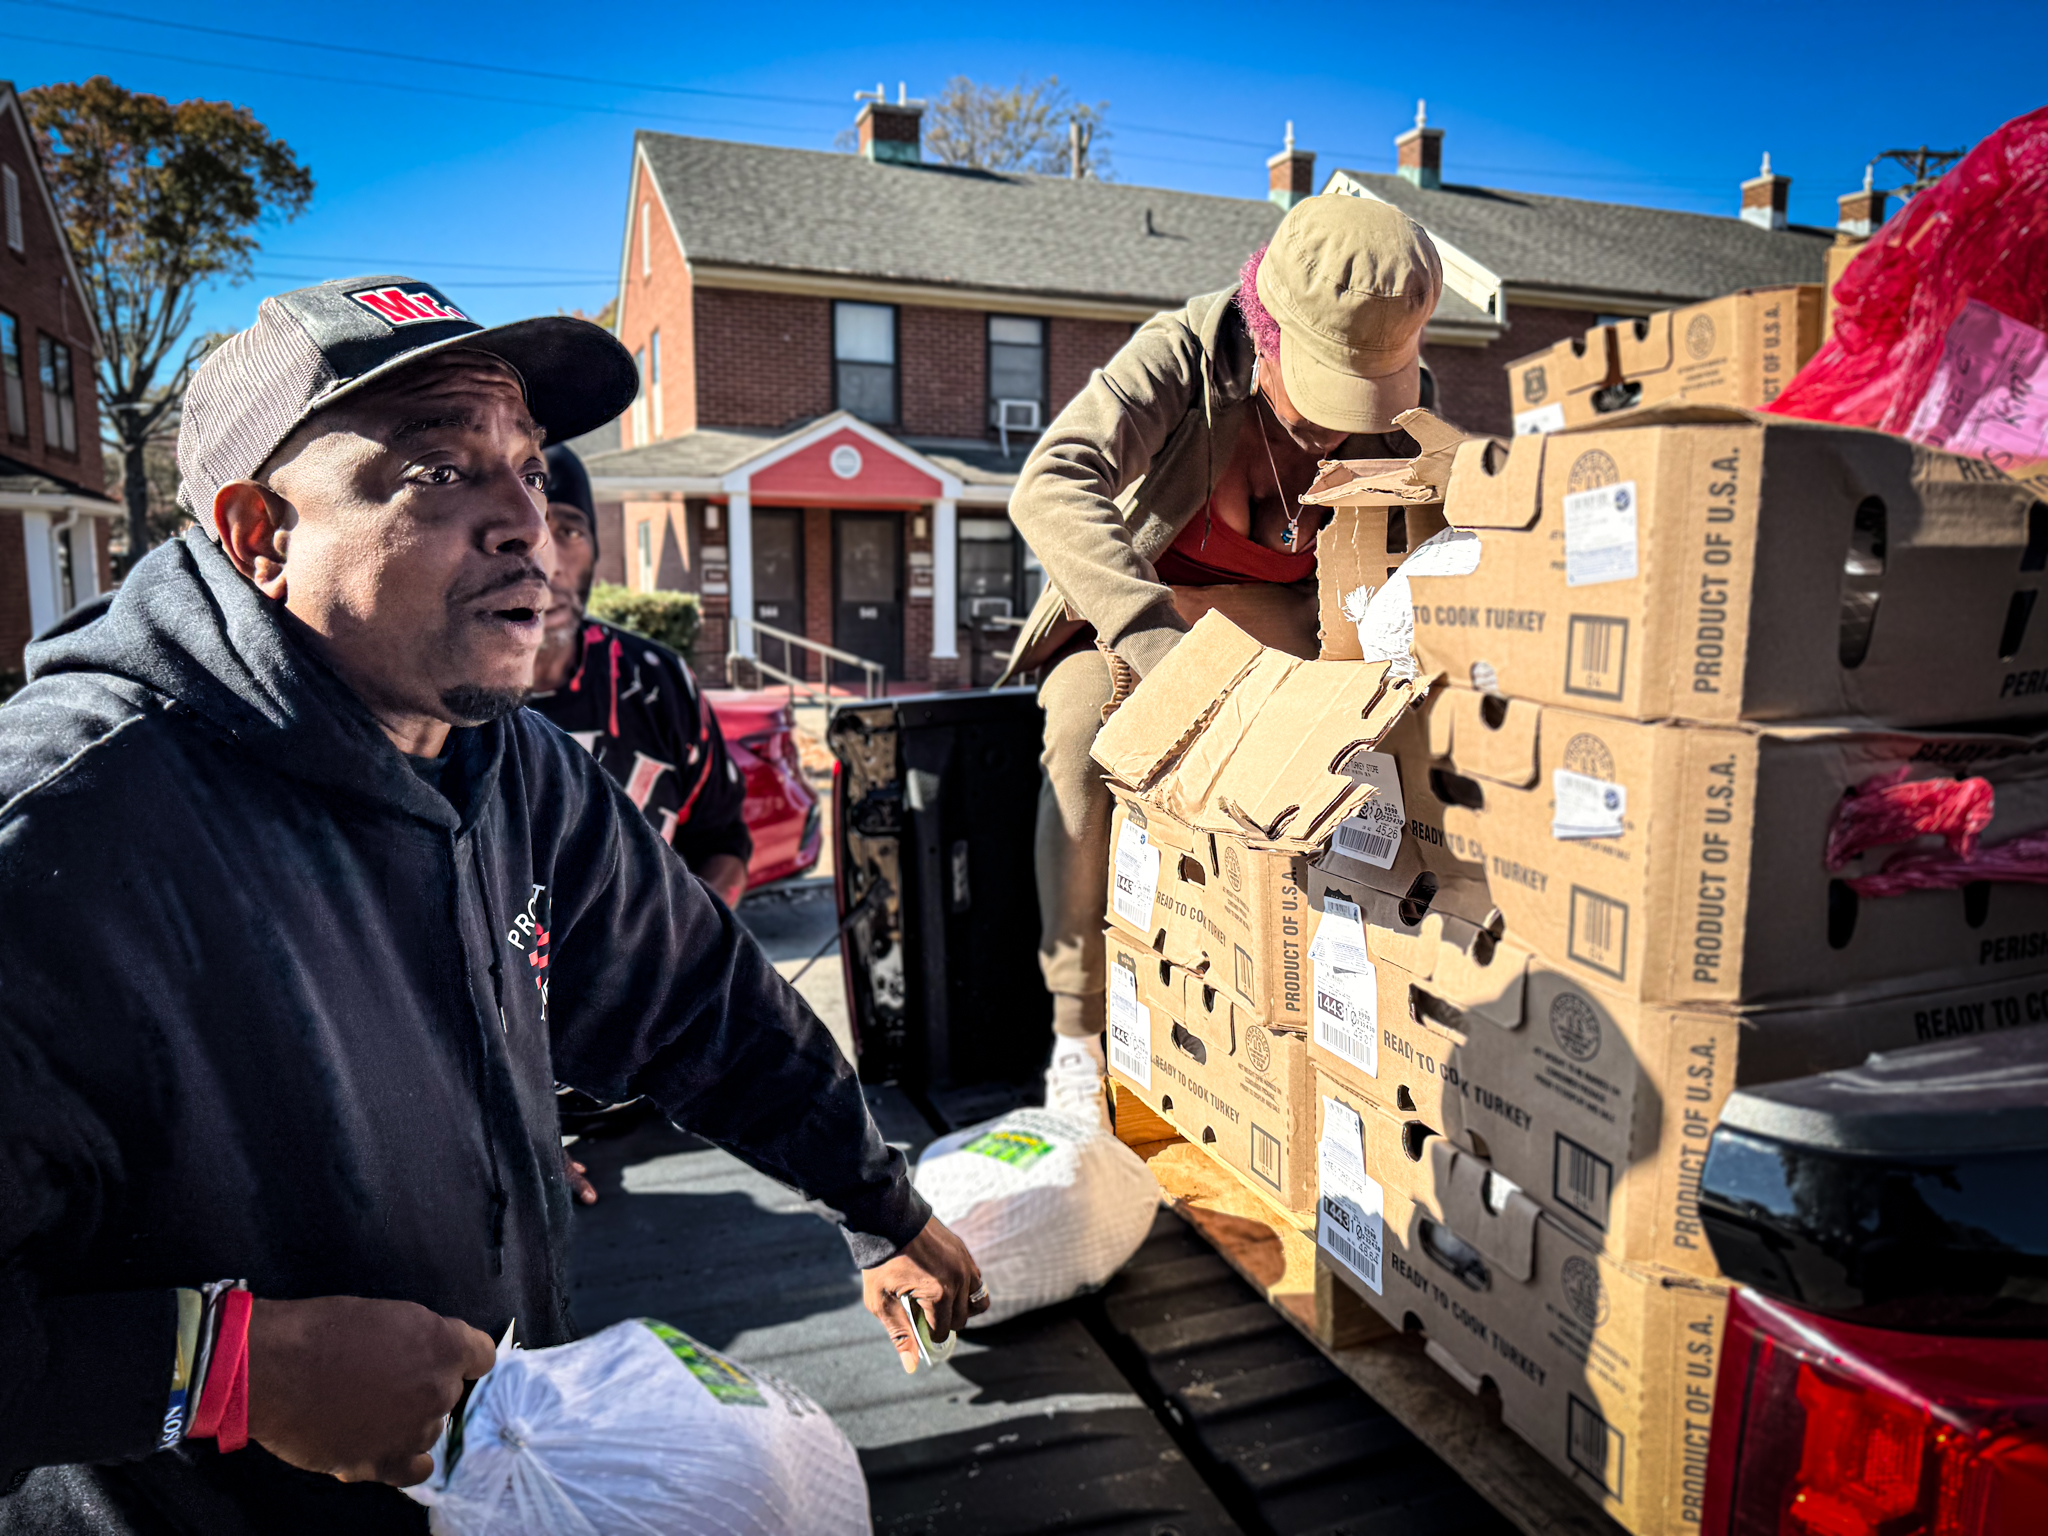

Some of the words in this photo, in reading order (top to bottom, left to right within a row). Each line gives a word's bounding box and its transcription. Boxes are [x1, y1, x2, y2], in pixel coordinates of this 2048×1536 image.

[352, 287, 468, 325] Mr.
[1705, 448, 1740, 523] U.S.A.
[1703, 533, 1732, 565] OF
[1413, 605, 1431, 626] TO
[1435, 606, 1479, 628] COOK
[1485, 608, 1546, 633] TURKEY
[1693, 574, 1729, 694] PRODUCT
[1704, 754, 1738, 824] U.S.A.
[1411, 819, 1444, 848] READY
[1446, 833, 1466, 855] TO
[1493, 856, 1549, 893] TURKEY
[1702, 832, 1730, 864] OF
[1175, 900, 1187, 917] TO
[1282, 867, 1298, 911] U.S.A.
[1283, 916, 1299, 936] OF
[1693, 871, 1727, 984] PRODUCT
[1284, 940, 1300, 1012] PRODUCT
[1318, 990, 1344, 1021] 1443
[1914, 1002, 1986, 1042] READY
[1990, 993, 2024, 1031] TO
[1384, 1029, 1413, 1063] READY
[1416, 1051, 1435, 1074] TO
[1474, 1085, 1533, 1131] TURKEY
[1686, 1036, 1717, 1102] U.S.A.
[1178, 1070, 1187, 1087] TO
[1188, 1078, 1209, 1103] COOK
[1210, 1092, 1240, 1125] TURKEY
[1683, 1107, 1709, 1140] OF
[1324, 1196, 1350, 1231] 1443
[1392, 1251, 1429, 1294] READY
[1432, 1284, 1449, 1309] TO
[1452, 1301, 1488, 1342] COOK
[1491, 1331, 1546, 1387] TURKEY
[1686, 1314, 1715, 1378] U.S.A.
[1685, 1384, 1711, 1414] OF
[1682, 1419, 1710, 1526] PRODUCT
